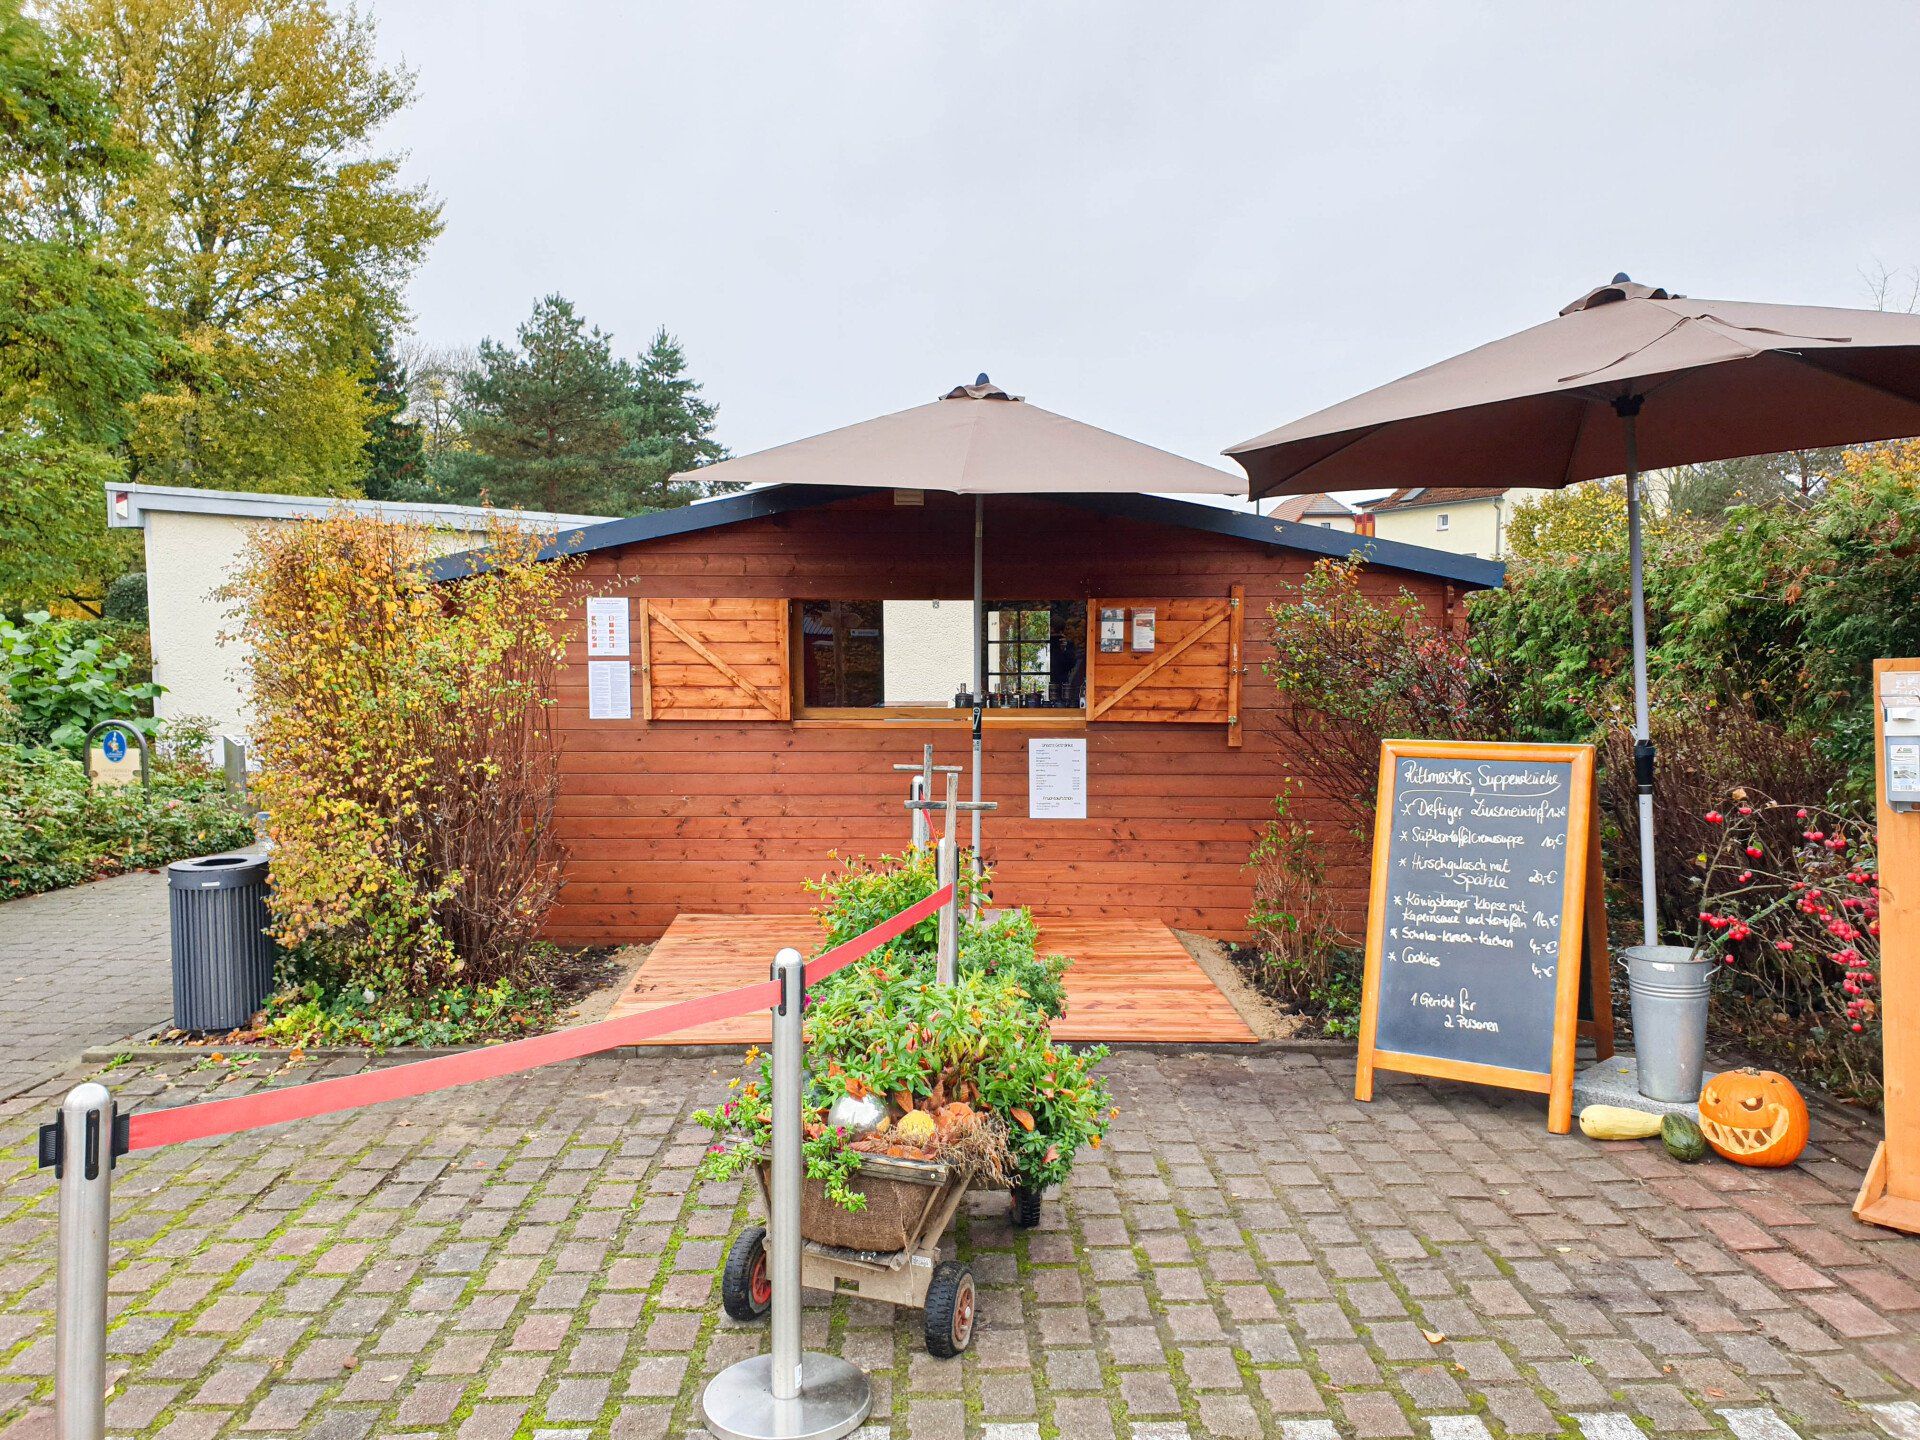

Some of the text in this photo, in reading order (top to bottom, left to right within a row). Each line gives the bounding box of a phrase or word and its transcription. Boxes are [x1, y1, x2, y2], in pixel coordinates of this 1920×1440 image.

[1402, 760, 1559, 791] Rittmeisters Suppenküche
[1413, 797, 1464, 825] Deftiger
[1471, 799, 1548, 824] Linseneintopf
[1412, 852, 1511, 877] Hirschgulasch mit
[1453, 872, 1509, 892] Spätzle
[1405, 891, 1471, 914] Königsberger
[1509, 900, 1528, 914] mit
[1402, 907, 1460, 926] Kapernsauce
[1465, 913, 1486, 925] und
[1402, 946, 1440, 967] Cookies
[1410, 987, 1476, 1015] 1 Gericht für
[1444, 1014, 1499, 1033] 2 Personen
